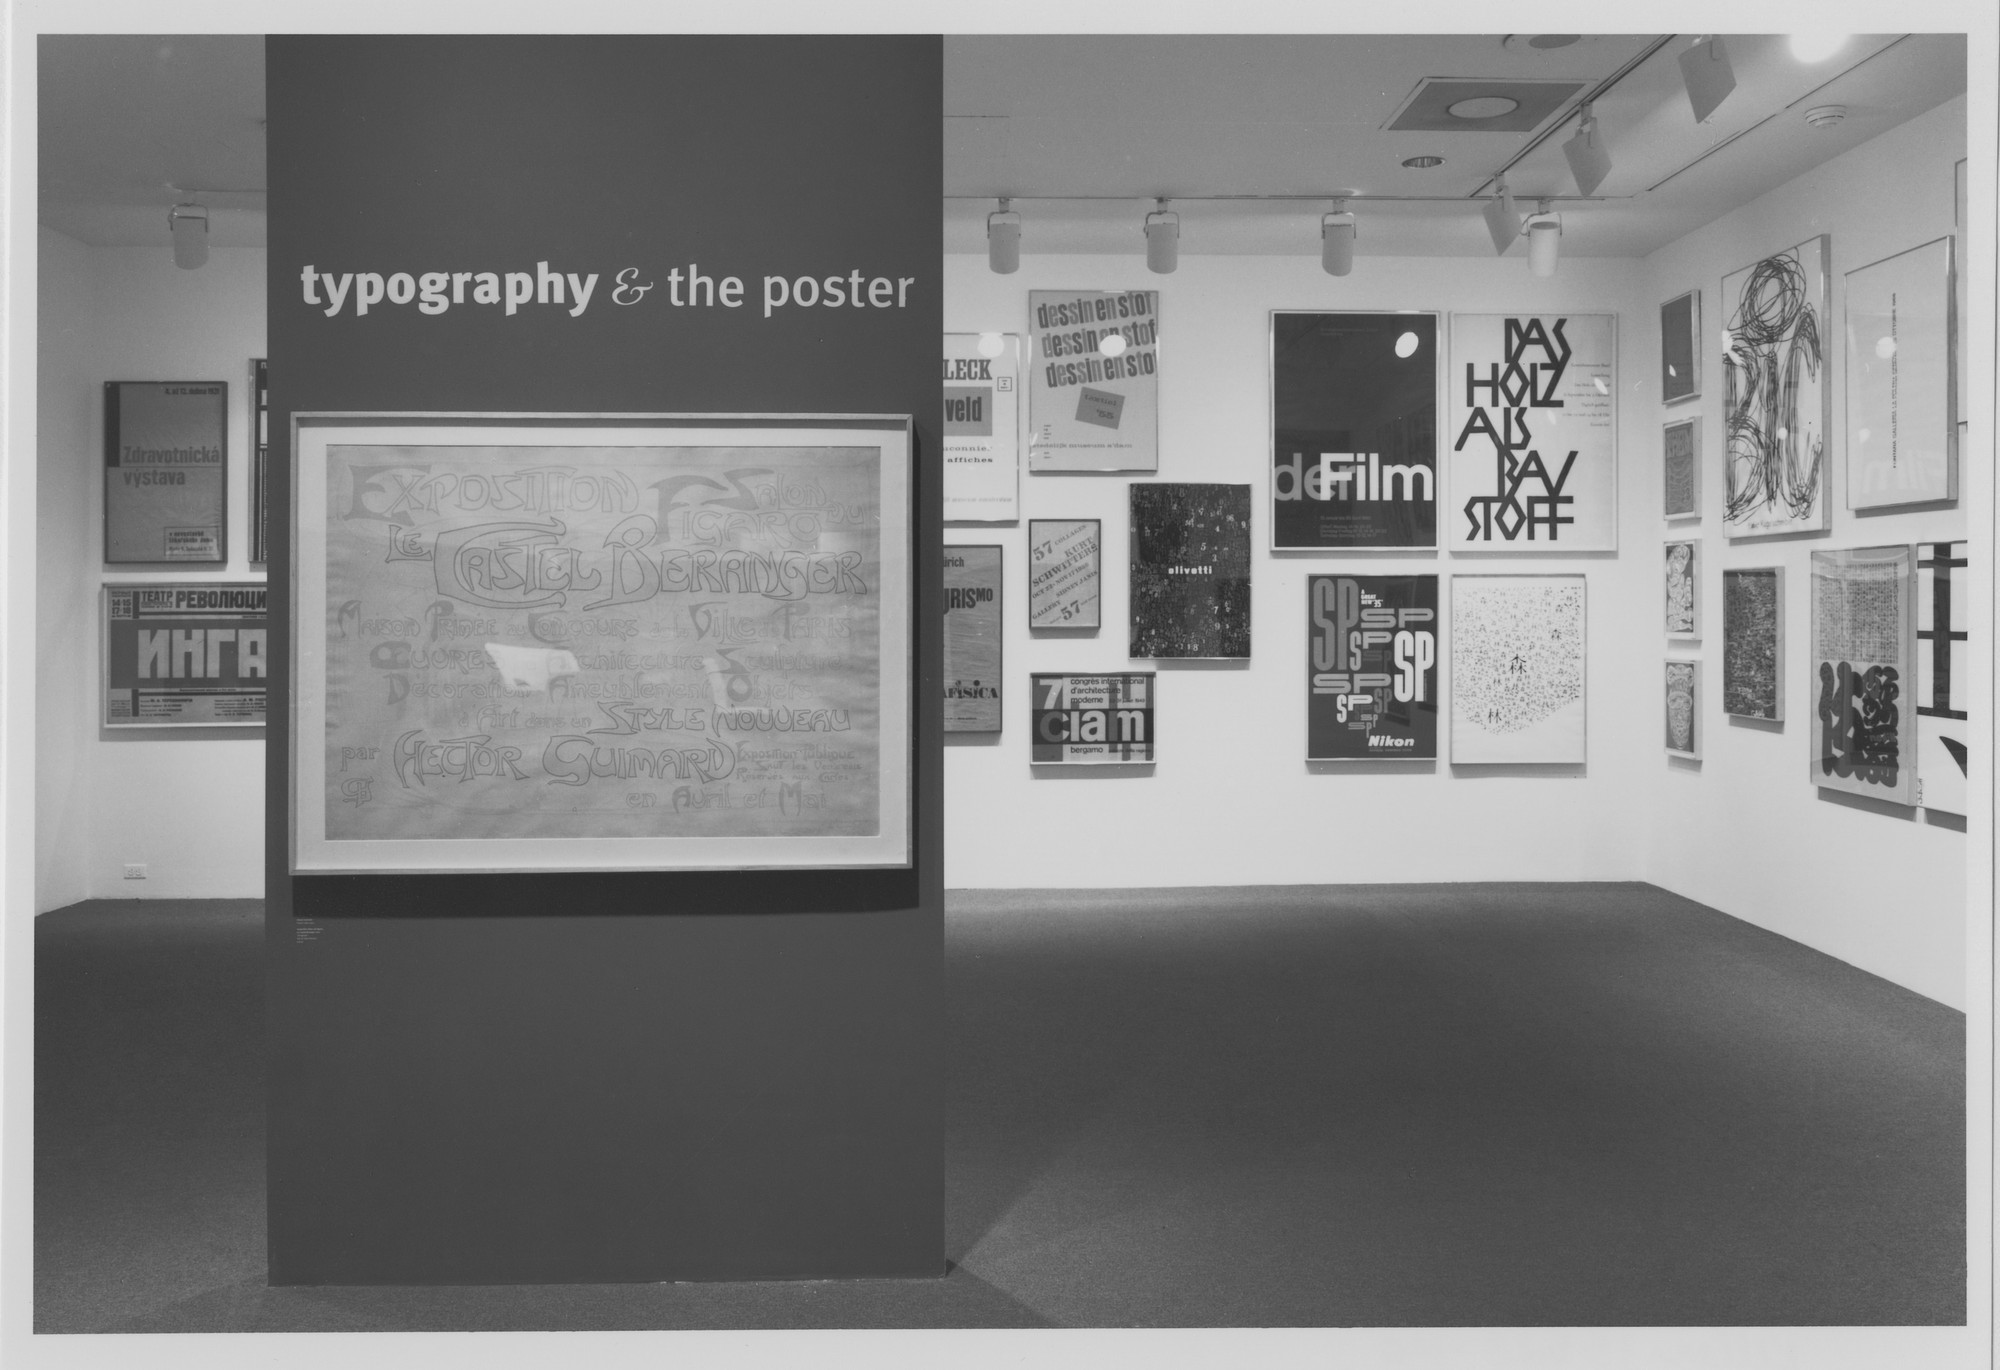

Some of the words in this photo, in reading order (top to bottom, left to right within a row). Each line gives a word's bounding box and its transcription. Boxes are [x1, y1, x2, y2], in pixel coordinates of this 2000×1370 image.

[301, 261, 599, 318] typography
[668, 263, 745, 308] the
[764, 269, 915, 318] poster
[1037, 299, 1094, 328] dessin
[1095, 297, 1117, 321] en
[1118, 291, 1152, 318] stof
[1042, 328, 1098, 358] dessin
[1504, 318, 1572, 364] DAS
[943, 359, 993, 380] LECK
[1046, 358, 1102, 388] dessin
[1103, 356, 1125, 380] en
[1466, 360, 1564, 407] HOLZ
[945, 396, 982, 422] veld
[123, 446, 220, 464] Zdravotnická
[123, 469, 186, 488] výstava
[1320, 453, 1434, 501] Film
[343, 464, 639, 526] EXPOSITION
[1464, 496, 1574, 541] STOFF
[1033, 540, 1053, 561] 57
[1064, 536, 1094, 558] KURT
[385, 524, 433, 564] LE
[433, 516, 602, 609] CASTEL
[583, 514, 867, 611] BERANGER
[1032, 543, 1098, 588] SCHWITTERS
[1168, 565, 1213, 575] olivetti
[141, 591, 173, 602] ТЕАТР
[1032, 600, 1061, 620] GALLERY
[1060, 599, 1080, 621] 57
[1313, 578, 1359, 671] SP
[1360, 608, 1434, 628] SP
[138, 629, 267, 679] ИНГА
[1350, 631, 1392, 671] SP
[1394, 630, 1435, 703] SP
[1070, 677, 1099, 686] congrès
[1070, 686, 1121, 694] d'architecture
[1313, 673, 1392, 694] SP
[1070, 696, 1103, 704] moderne
[1337, 694, 1373, 723] SP
[1373, 688, 1393, 714] SP
[586, 701, 705, 735] STYLE
[1070, 746, 1103, 754] bergamo
[1368, 735, 1415, 748] Nikon
[340, 746, 381, 772] par
[394, 730, 531, 788] HECTOR
[542, 735, 736, 784] GUIMARD
[626, 791, 657, 808] en
[672, 783, 731, 814] Avril
[744, 788, 766, 809] et
[779, 782, 828, 816] Mai
